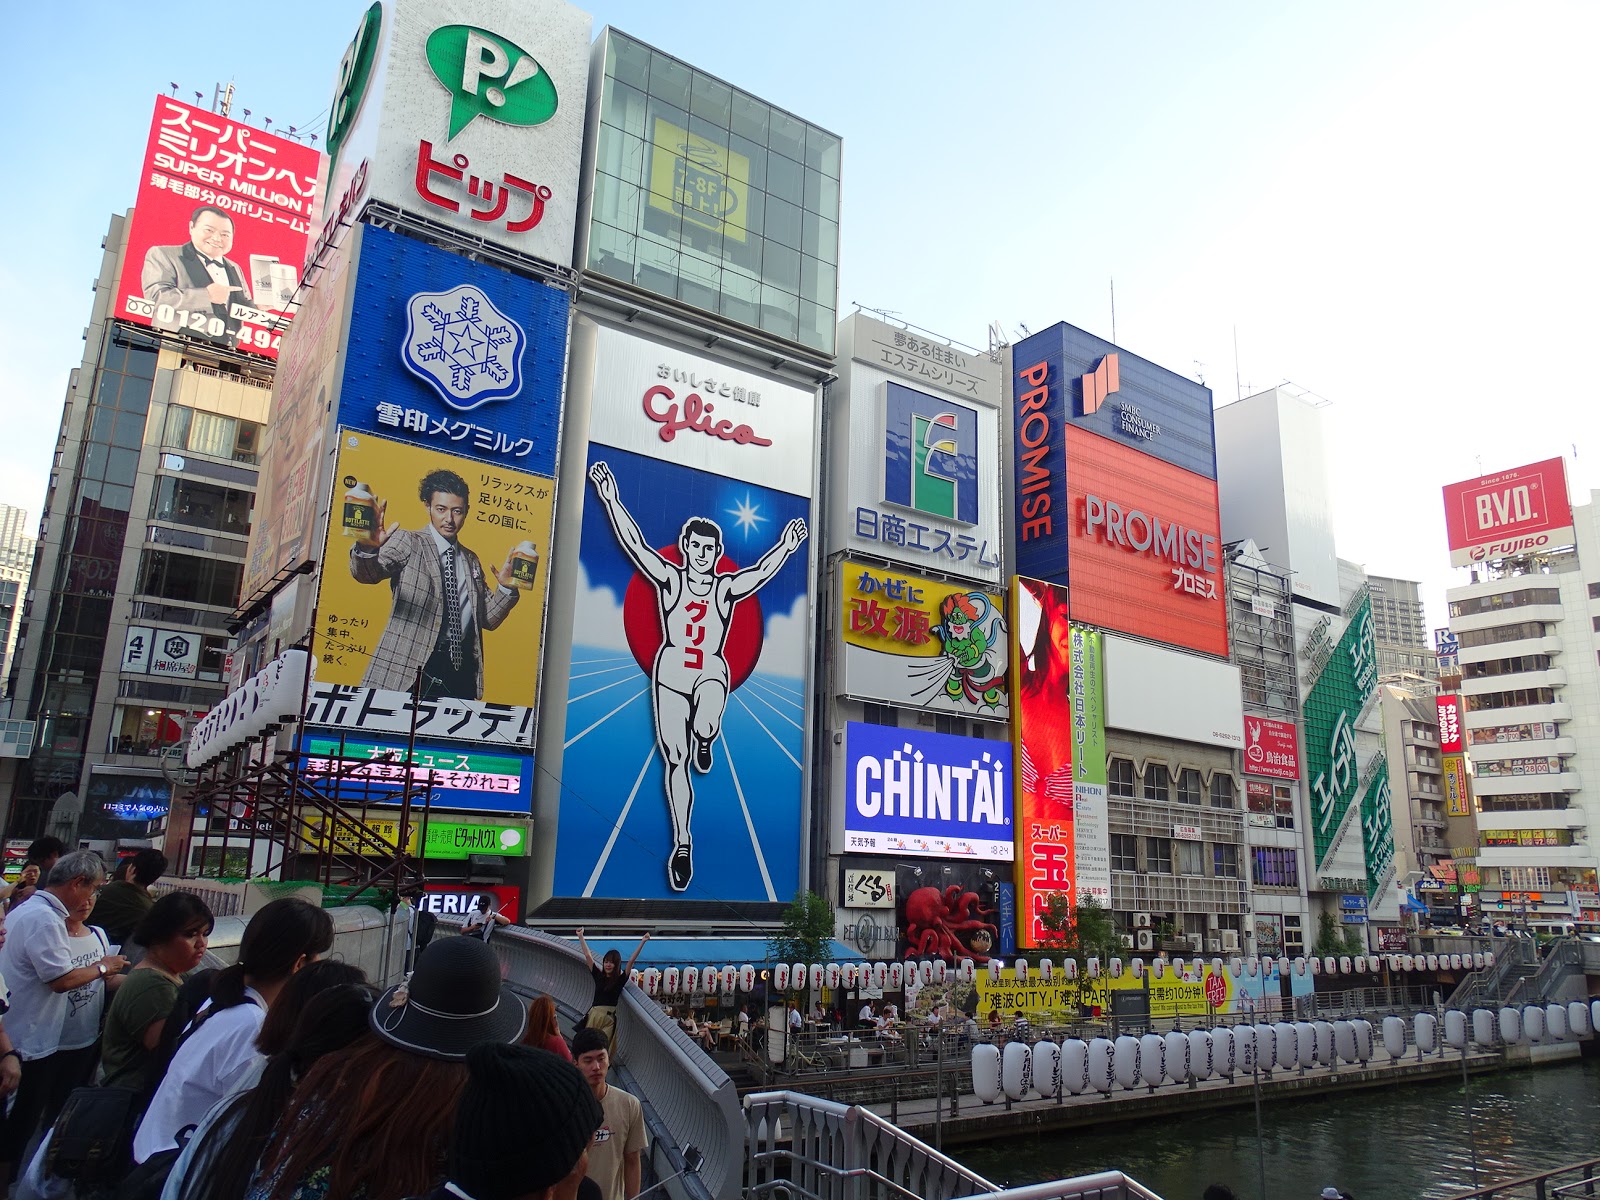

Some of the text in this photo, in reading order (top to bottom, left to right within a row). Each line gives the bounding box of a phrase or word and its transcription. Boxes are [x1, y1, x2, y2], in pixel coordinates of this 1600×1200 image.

[161, 102, 277, 155] スーパー
[154, 152, 303, 213] SUPER MILLION
[415, 138, 553, 234] ピップ
[893, 331, 967, 369] 夢ある住まい
[657, 363, 761, 408] おいしさと健康
[880, 348, 979, 395] エステムシリーズ
[642, 385, 773, 447] Glico
[1120, 401, 1141, 418] SMBC
[1120, 410, 1162, 435] CONSUMER
[375, 400, 534, 457] 雪印メグミルク
[1121, 422, 1154, 441] FINANCE
[1018, 360, 1052, 542] PROMISE
[344, 478, 357, 487] NEW
[480, 473, 550, 500] リラックスが
[1481, 477, 1500, 486] Since
[478, 492, 534, 516] 足りない、
[1475, 484, 1539, 531] B.V.D.
[475, 510, 533, 534] この国に。
[855, 506, 1001, 569] 日商エステム
[1086, 494, 1217, 574] PROMISE
[1489, 534, 1549, 557] FUJIBO
[857, 571, 925, 605] かぜに
[1171, 568, 1219, 601] プロミス
[326, 626, 355, 640] 集中、
[327, 613, 369, 629] ゆったり
[683, 599, 710, 671] グリコ
[849, 596, 932, 646] 改源
[128, 635, 145, 663] 4F
[322, 653, 348, 668] 続く。
[324, 639, 367, 656] たっぷり
[1072, 631, 1088, 780] 株式会社日本リート
[1437, 705, 1450, 744] JOYSOUND
[1446, 703, 1460, 744] カラオケ
[367, 746, 471, 771] 大阪ニュース
[1313, 709, 1358, 835] エイブル
[855, 744, 1004, 825] CHINTAI
[1075, 786, 1102, 796] NIHON
[1031, 822, 1067, 841] スーパー
[1365, 776, 1391, 854] エイブル
[454, 827, 498, 853] ピタットハウス
[850, 836, 876, 848] 天気予報
[993, 881, 1000, 903] 2F
